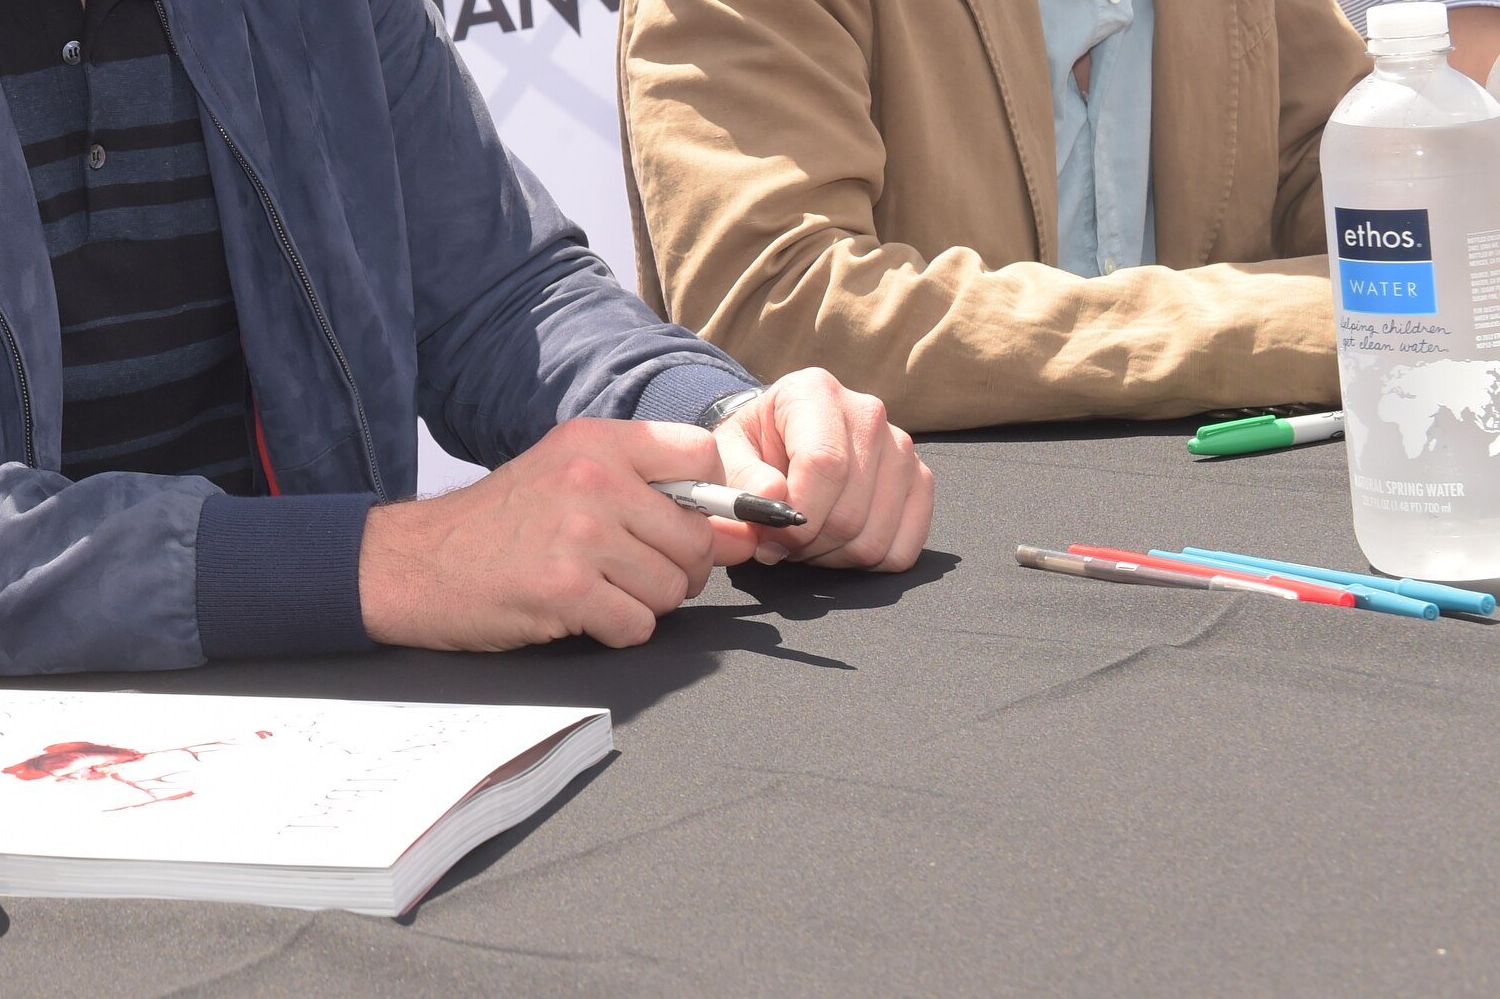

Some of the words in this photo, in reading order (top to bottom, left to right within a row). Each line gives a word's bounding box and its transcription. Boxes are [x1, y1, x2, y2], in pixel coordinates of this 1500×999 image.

[1349, 279, 1418, 297] WATER
[1382, 318, 1452, 335] children
[1359, 336, 1394, 351] clean
[1386, 481, 1423, 497] SPRING
[1425, 482, 1465, 497] WATER
[1423, 502, 1440, 513] 700
